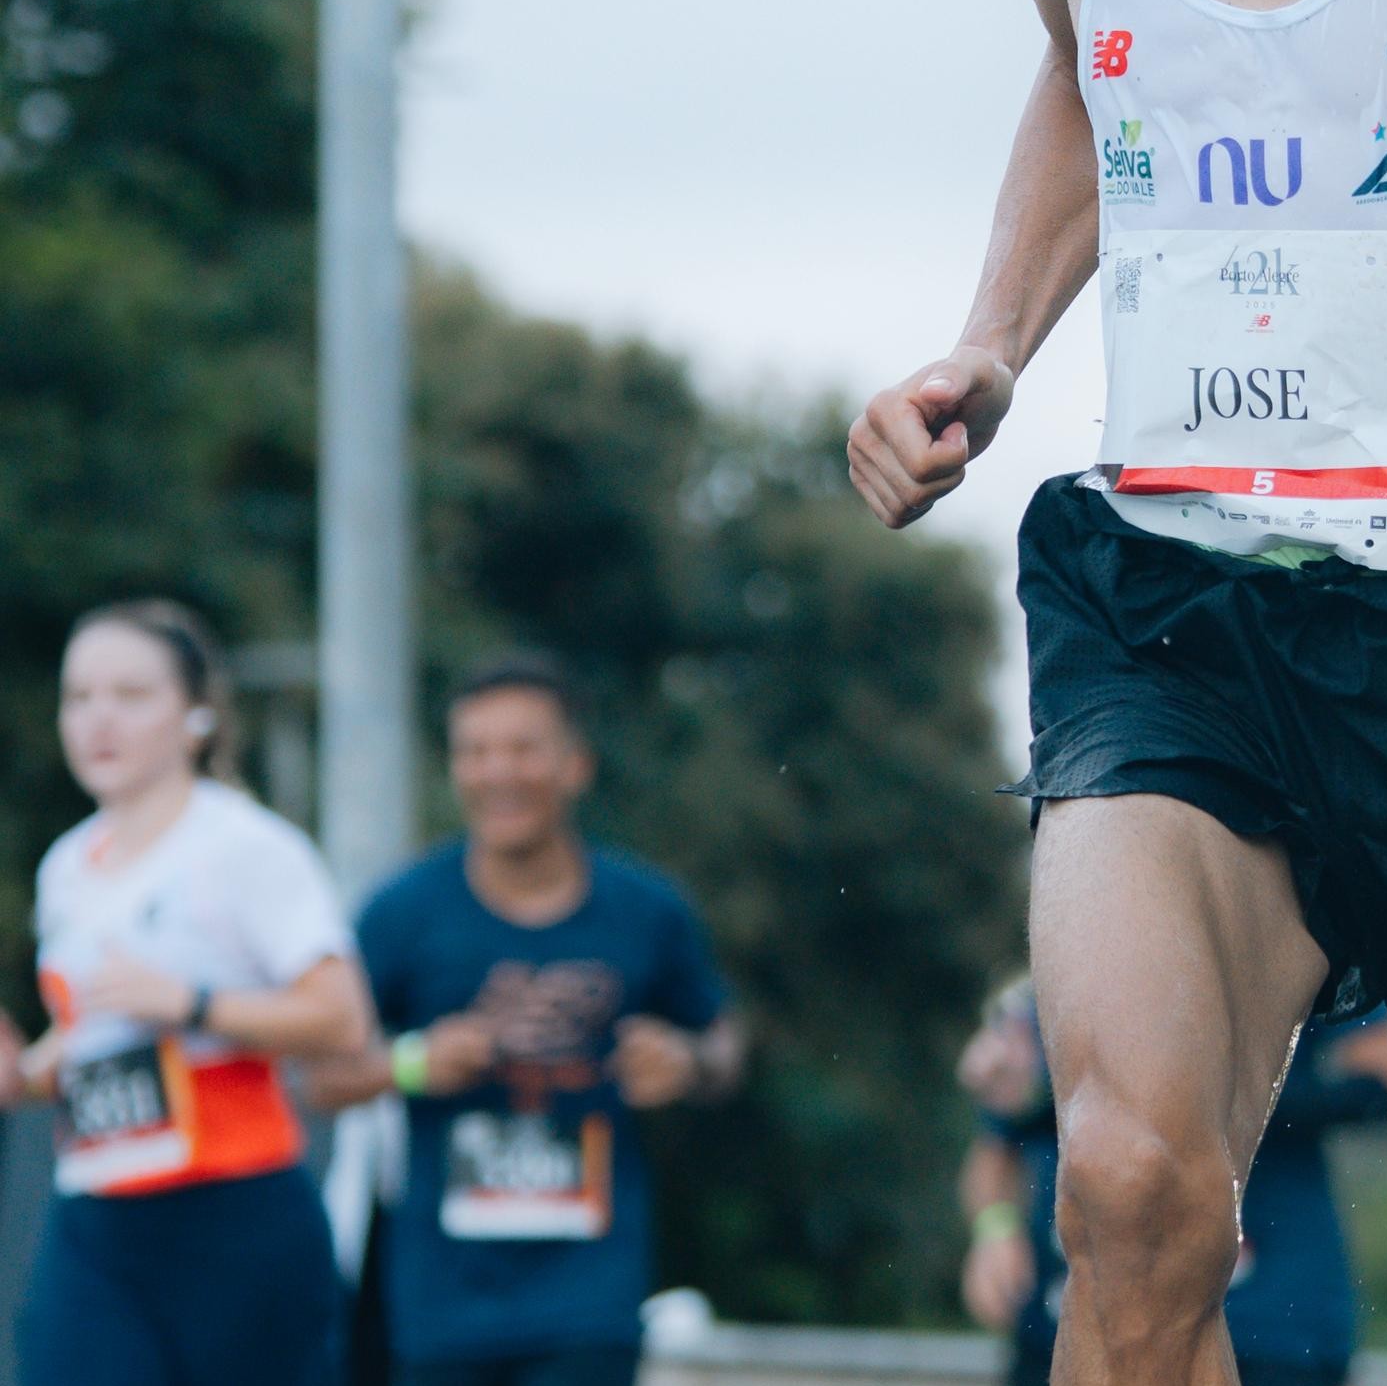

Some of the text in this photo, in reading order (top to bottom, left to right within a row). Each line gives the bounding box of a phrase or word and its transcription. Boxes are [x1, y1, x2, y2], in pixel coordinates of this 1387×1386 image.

[1104, 137, 1153, 180] Seiva
[1219, 267, 1300, 286] Porto Alegre
[1245, 300, 1276, 310] 2025
[1184, 366, 1309, 432] JOSE
[1251, 471, 1276, 494] 5
